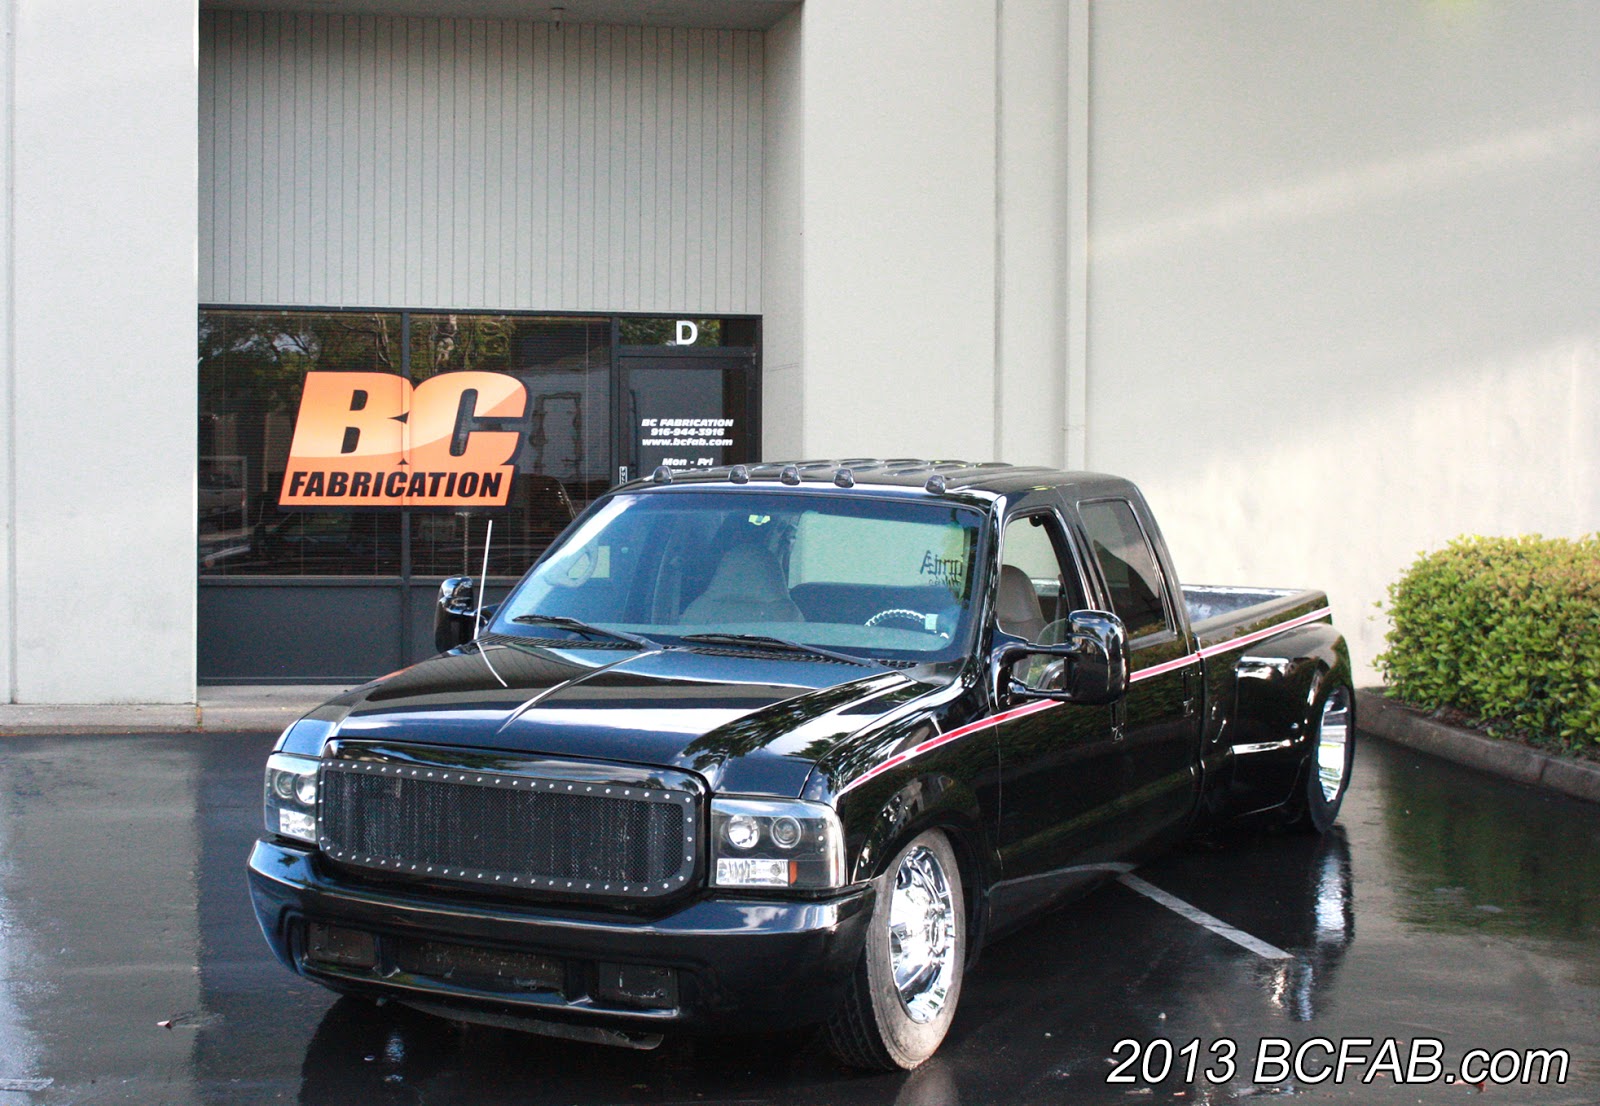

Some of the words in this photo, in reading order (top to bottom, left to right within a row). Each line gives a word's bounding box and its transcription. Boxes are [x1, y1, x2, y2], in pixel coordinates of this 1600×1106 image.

[675, 320, 698, 345] D
[284, 371, 527, 466] BC
[641, 419, 658, 427] BC
[659, 419, 734, 427] FABRICATION
[650, 428, 725, 436] 916-944-3916
[641, 438, 733, 446] www.bcfab.com
[661, 458, 687, 466] Mon
[697, 458, 714, 466] Fri
[288, 471, 503, 498] FABRICATION
